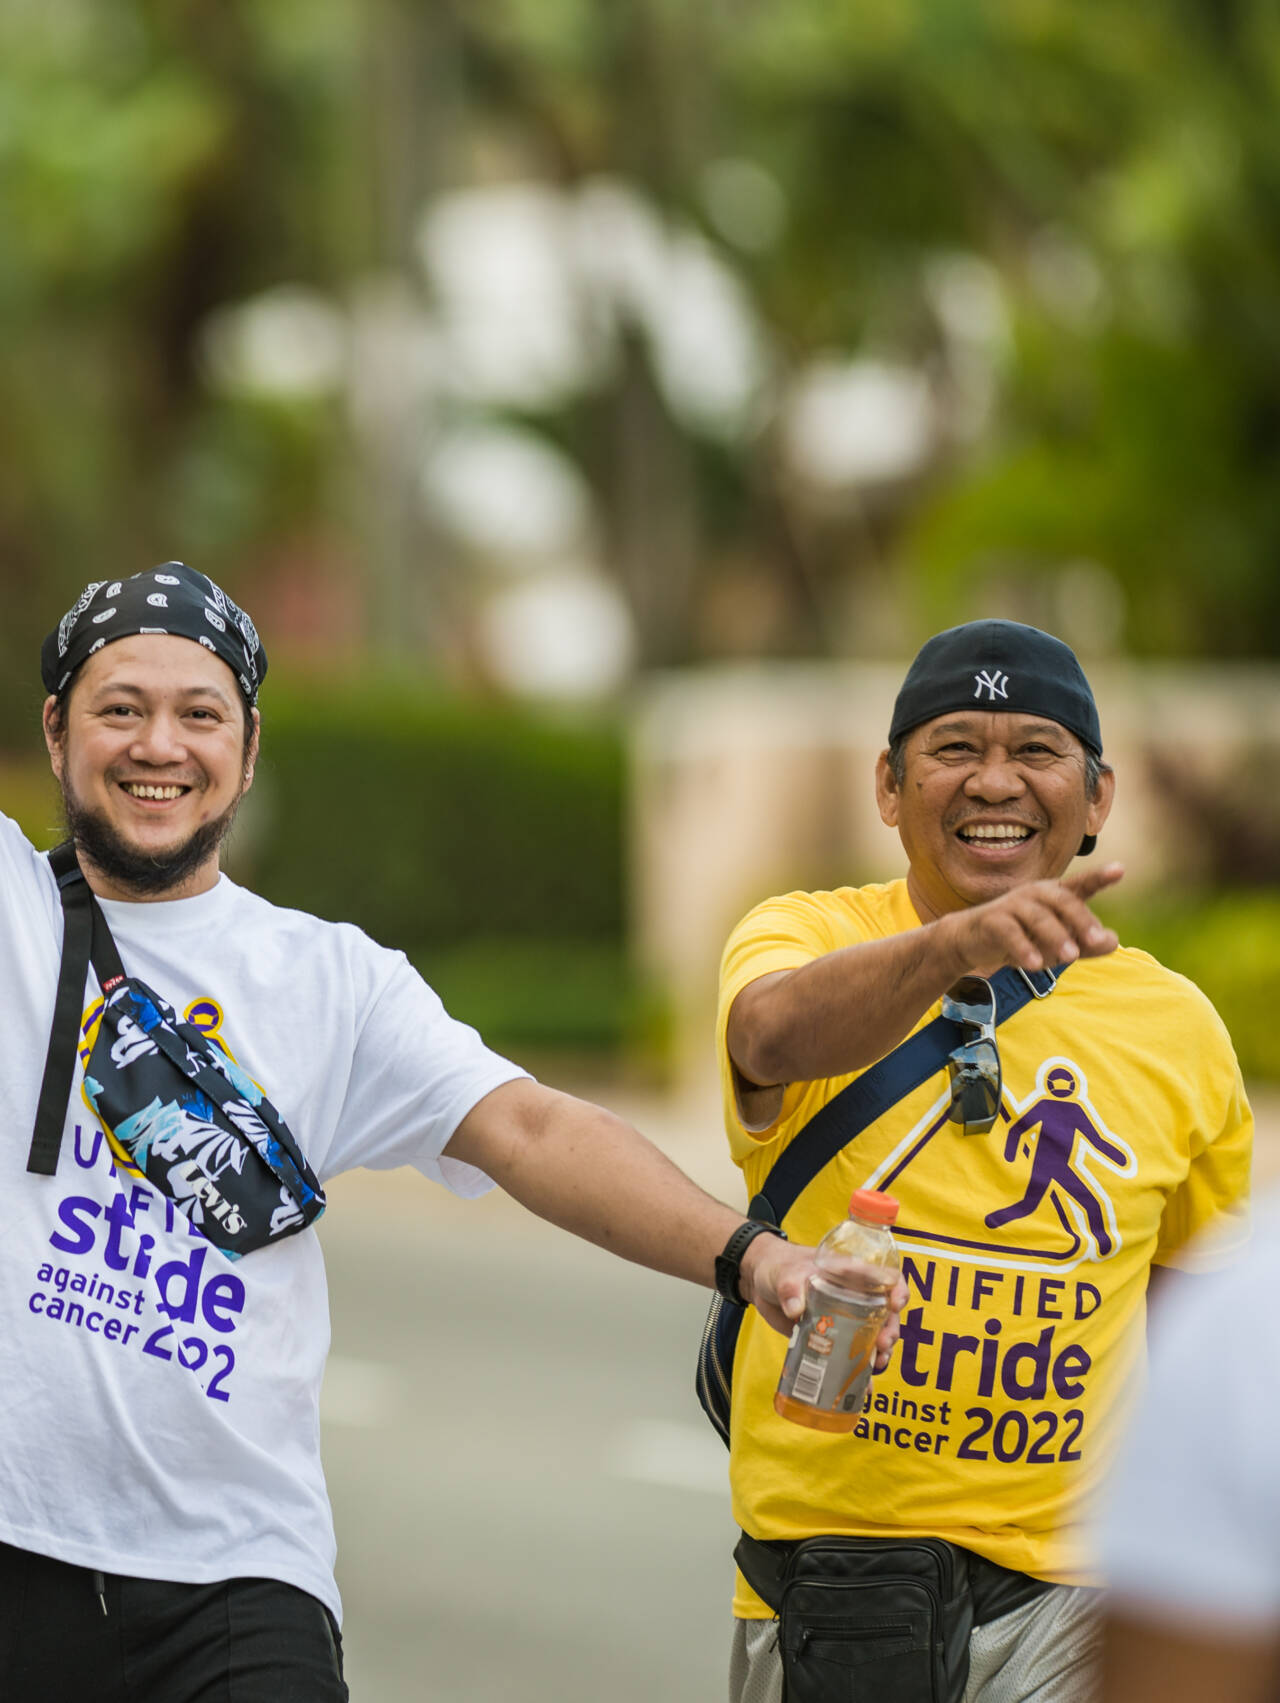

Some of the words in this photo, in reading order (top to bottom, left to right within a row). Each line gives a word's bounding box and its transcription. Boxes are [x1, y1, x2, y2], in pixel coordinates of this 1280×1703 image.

[974, 670, 1009, 700] NY
[36, 1262, 145, 1316] against
[48, 1192, 245, 1333] stide
[902, 1256, 1101, 1321] NIFIED
[28, 1291, 140, 1345] cancer
[142, 1324, 235, 1403] 202
[872, 1306, 1091, 1401] tride
[853, 1417, 950, 1455] ancer
[957, 1407, 1084, 1464] 2022
[863, 1391, 951, 1425] gainst
